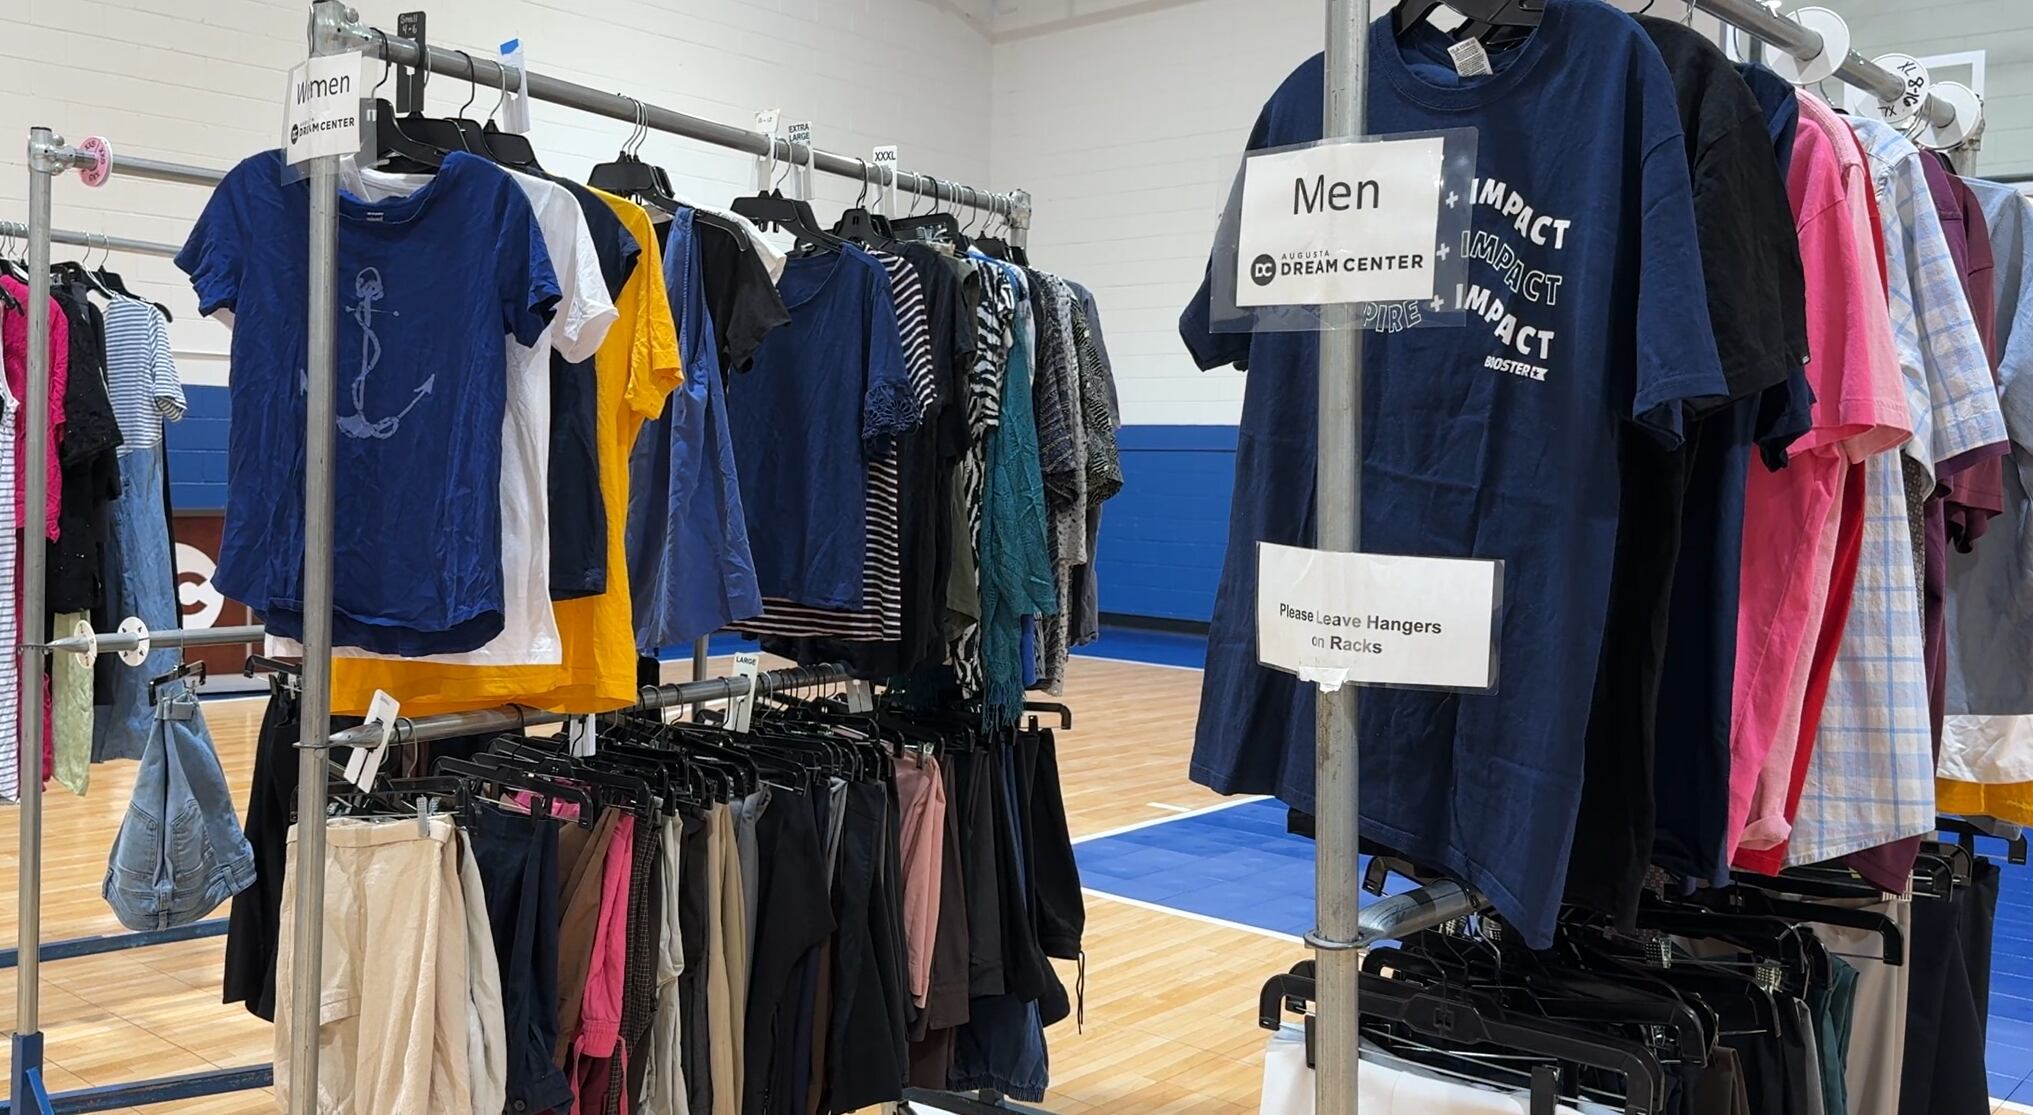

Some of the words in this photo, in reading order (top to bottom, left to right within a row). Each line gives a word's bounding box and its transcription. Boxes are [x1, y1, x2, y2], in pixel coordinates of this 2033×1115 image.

[1897, 61, 1916, 76] XL
[320, 117, 355, 131] CENTER
[788, 123, 810, 133] EXTRA
[875, 151, 896, 161] XXXL
[1293, 174, 1380, 215] Men
[1469, 178, 1571, 249] IMPACT
[1281, 250, 1330, 260] AUGUSTA
[1281, 259, 1338, 276] DREAM
[1343, 254, 1424, 272] CENTER
[1460, 230, 1563, 306] IMPACT
[1363, 299, 1422, 333] PIRE
[1455, 283, 1555, 360] IMPACT
[1279, 603, 1314, 622] Please
[1317, 611, 1361, 629] Leave
[1367, 615, 1442, 635] Hangers
[1311, 636, 1325, 649] on
[1330, 636, 1382, 654] Racks
[736, 656, 756, 665] LARGE
